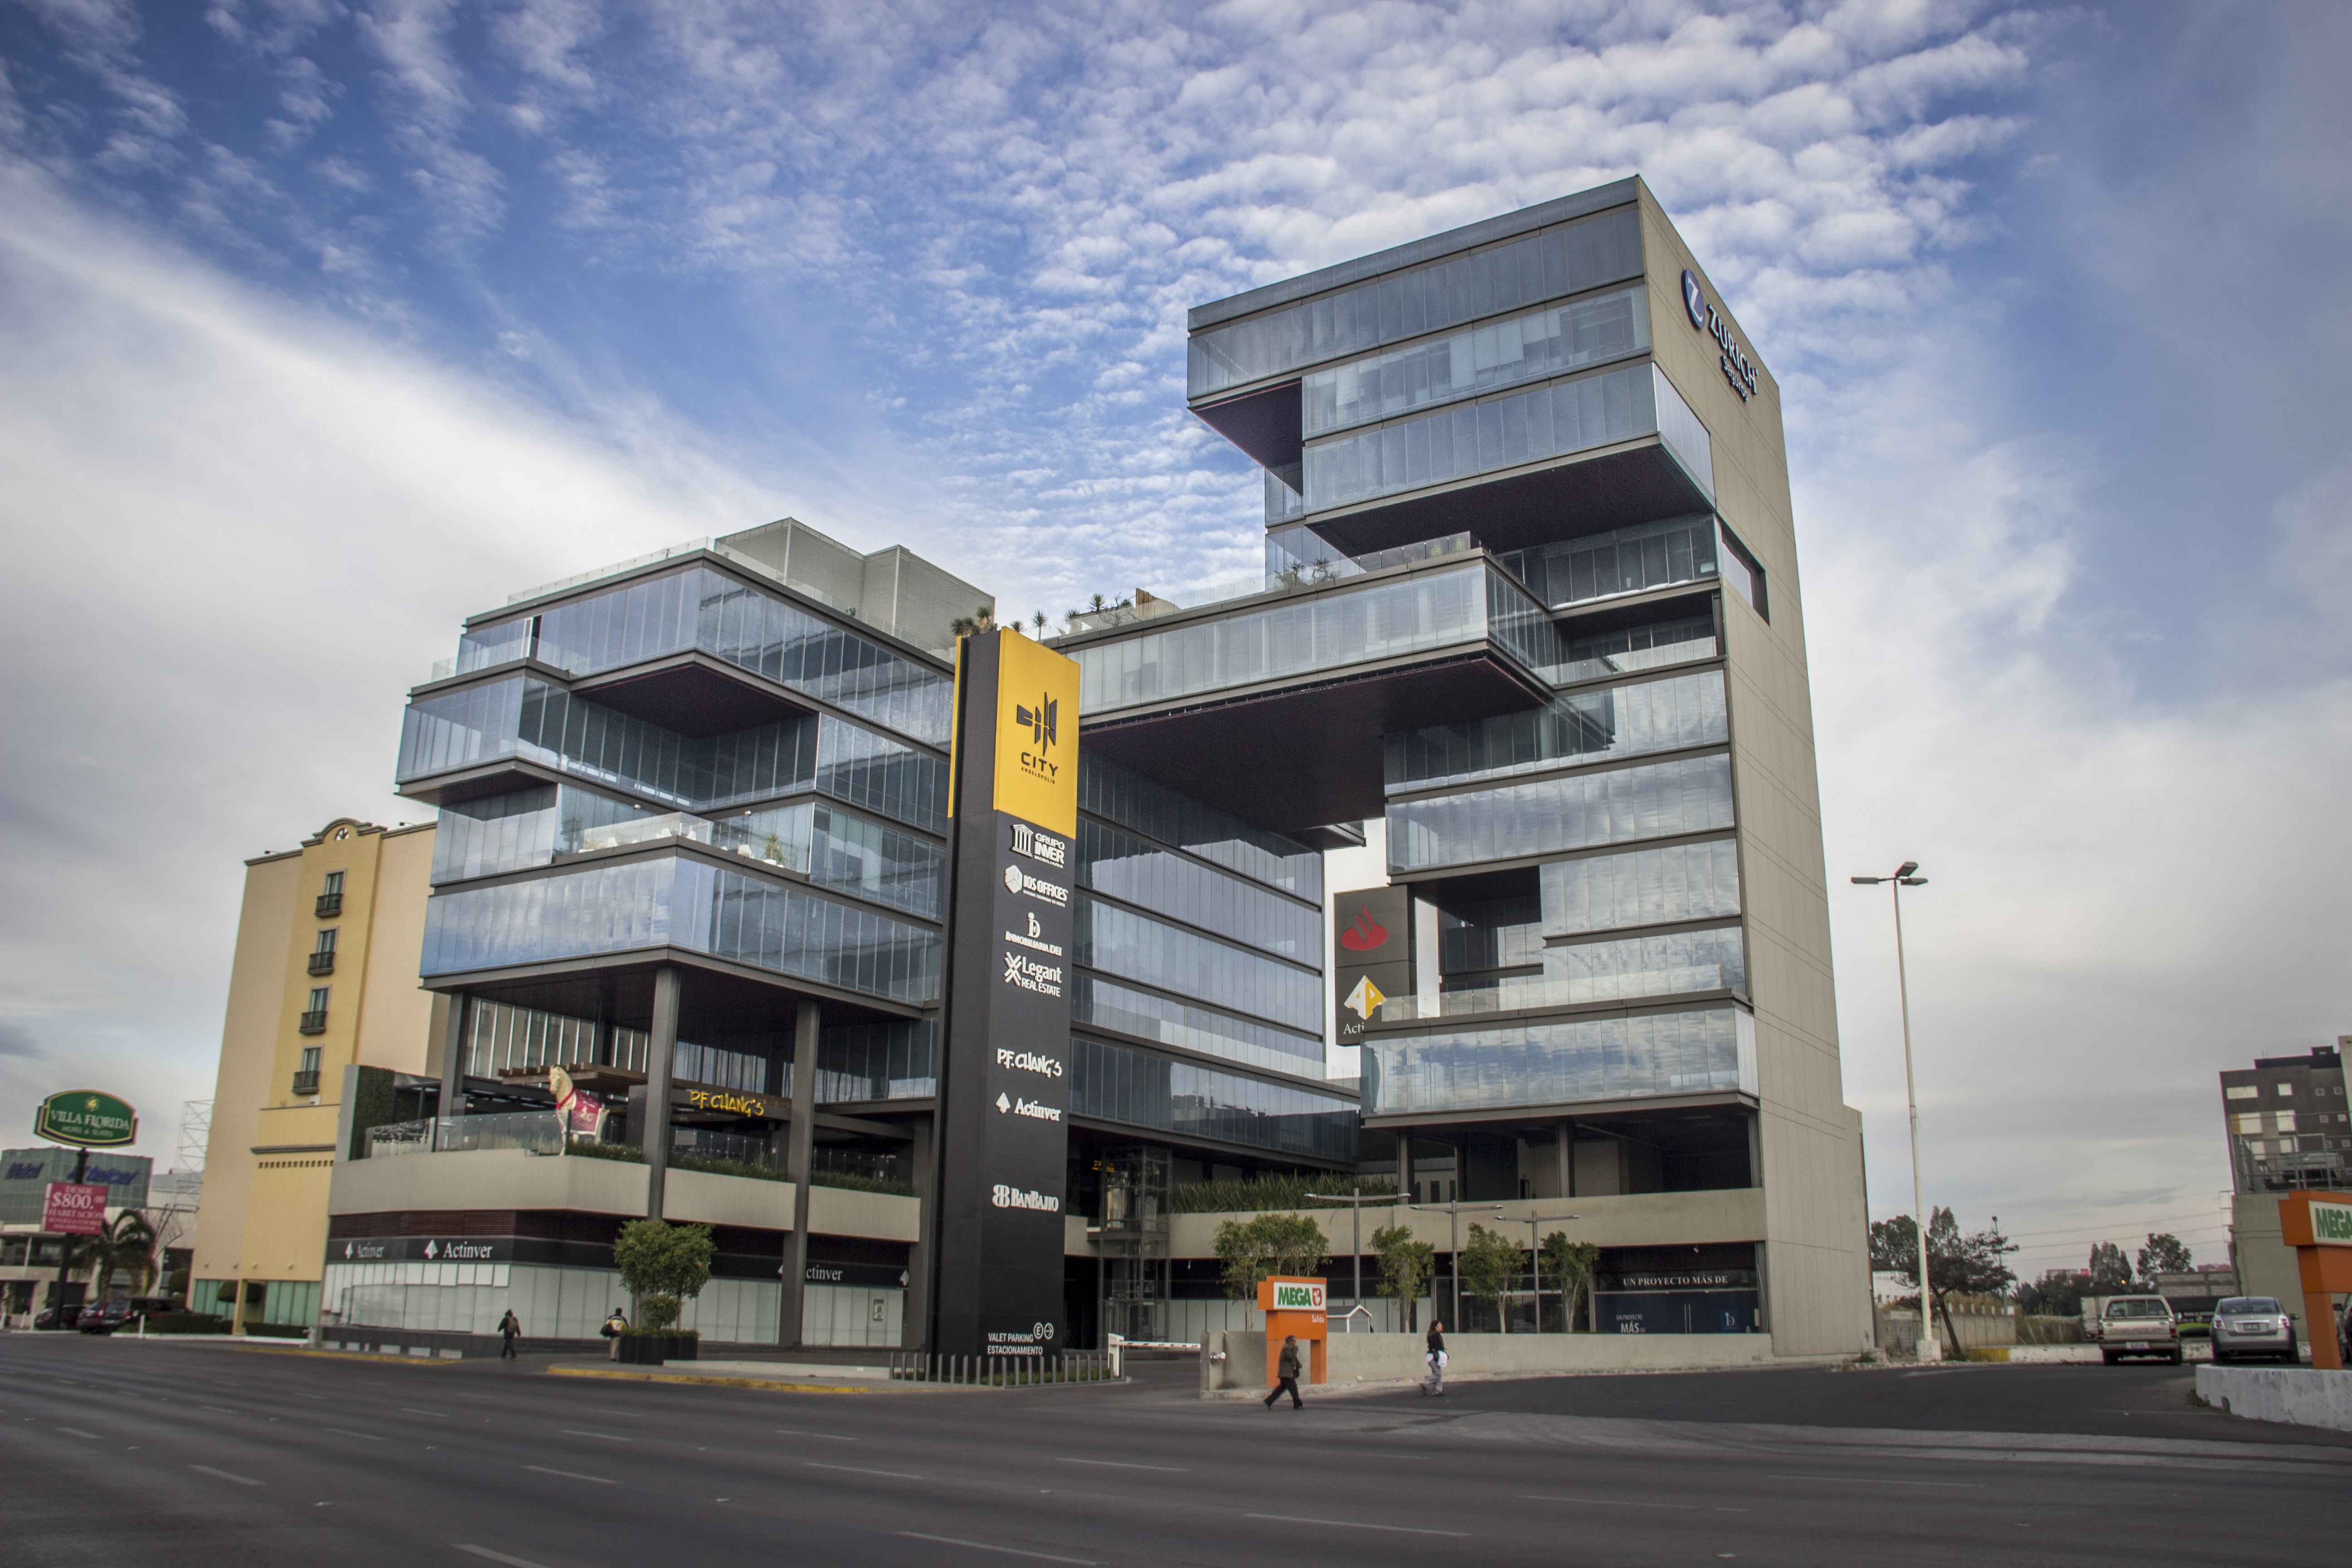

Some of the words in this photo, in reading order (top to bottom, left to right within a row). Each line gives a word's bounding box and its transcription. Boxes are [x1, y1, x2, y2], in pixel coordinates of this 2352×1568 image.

[1707, 304, 1758, 395] ZURICH
[1021, 752, 1058, 776] CITY
[1035, 833, 1065, 850] GRUPO
[1034, 841, 1064, 864] INVER
[1034, 855, 1063, 869] MOBILIARIA
[1023, 875, 1037, 891] IOS
[1037, 880, 1068, 902] OFFICES
[1005, 931, 1049, 953] INMOBILIARIA
[1049, 944, 1062, 956] DEI
[1022, 956, 1062, 983] Legant
[1021, 977, 1038, 991] REAL
[1038, 982, 1061, 997] ESTATE
[1343, 1021, 1364, 1034] Acti
[1014, 1097, 1061, 1122] Actinver
[50, 1110, 83, 1124] VILLA
[83, 1114, 130, 1130] FLORIDA
[2314, 1207, 2352, 1240] MEGA
[442, 1240, 493, 1258] Actinver
[804, 1264, 843, 1281] ctinver
[1623, 1277, 1636, 1286] UN
[1638, 1276, 1690, 1286] PROYECTO
[1692, 1274, 1713, 1284] MÁS
[1715, 1275, 1728, 1284] DE
[1278, 1286, 1312, 1306] MEGA
[1312, 1314, 1324, 1323] Salida
[1621, 1320, 1640, 1333] MÁS
[988, 1333, 1007, 1343] VALET
[1008, 1333, 1034, 1343] PARKING
[987, 1345, 1043, 1355] ESTACIONAMIENTO
